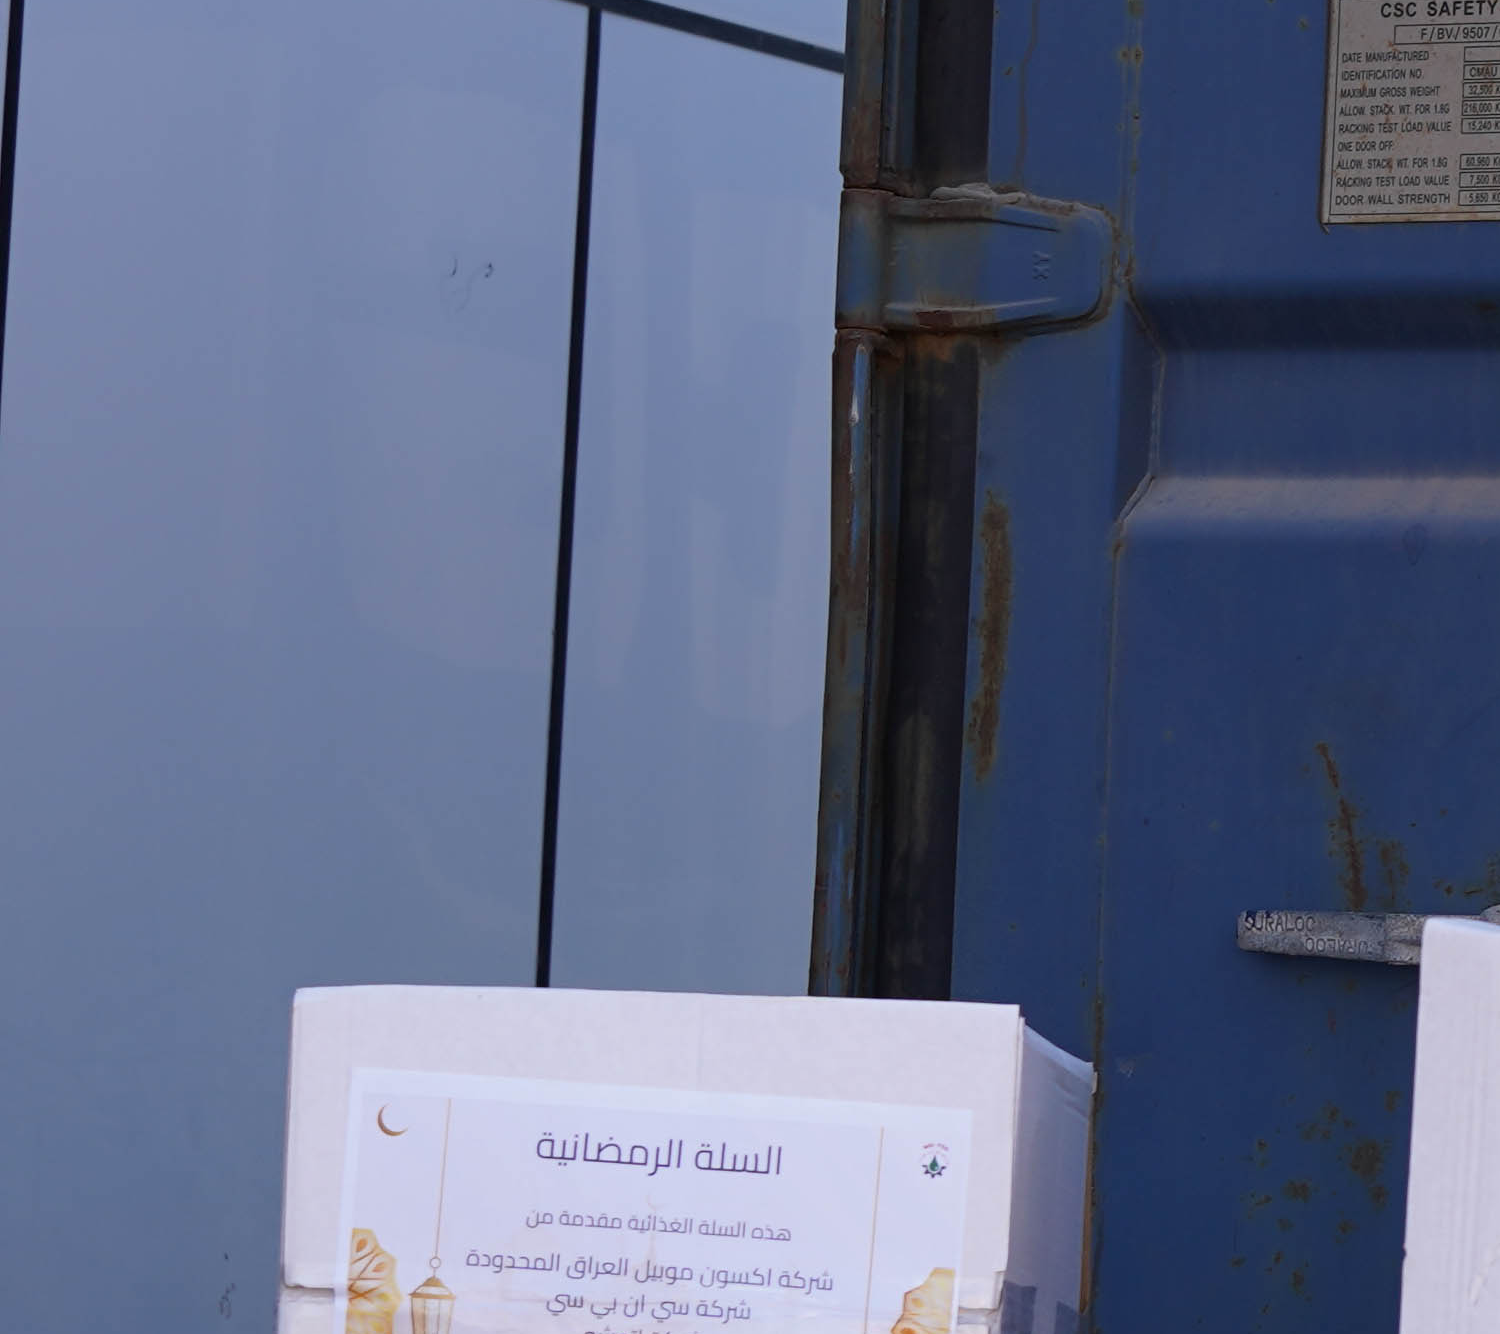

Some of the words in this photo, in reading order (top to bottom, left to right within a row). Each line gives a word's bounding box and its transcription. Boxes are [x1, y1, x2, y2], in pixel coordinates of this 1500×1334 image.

[1381, 2, 1416, 18] CSC
[1427, 0, 1497, 16] SAFETY
[1342, 52, 1361, 62] DATE
[1366, 51, 1429, 62] MANUFACTURED
[1342, 69, 1406, 81] IDENTIFICATION
[1470, 67, 1497, 77] CMAU
[1340, 87, 1376, 98] MAXIMUM
[1380, 86, 1407, 97] GROSS
[1410, 86, 1440, 96] WEIGHT
[1415, 104, 1430, 114] FOR
[1339, 123, 1374, 134] RACKING
[1378, 122, 1398, 133] TEST
[1401, 122, 1423, 132] LOAD
[1426, 121, 1452, 131] VALUE
[1338, 141, 1353, 152] ONE
[1355, 141, 1376, 151] DOOR
[1413, 157, 1428, 167] FOR
[1336, 176, 1372, 187] RACKING
[1376, 176, 1396, 186] TEST
[1399, 175, 1420, 186] LOAD
[1425, 175, 1449, 185] VALUE
[1336, 194, 1363, 205] DOOR
[1369, 194, 1393, 205] WALL
[1398, 193, 1450, 204] STRENGTH
[537, 1131, 682, 1176] الرمضانية
[694, 1142, 782, 1175] السلة
[525, 1210, 554, 1229] من
[559, 1210, 622, 1229] مقدمة
[699, 1220, 746, 1240] السلة
[751, 1225, 792, 1241] هذه
[466, 1249, 560, 1273] المحدودة
[567, 1255, 628, 1280] العراق
[635, 1259, 693, 1285] موبيل
[700, 1267, 771, 1289] اكسون
[779, 1268, 833, 1294] شركة
[696, 1299, 751, 1323] شركة
